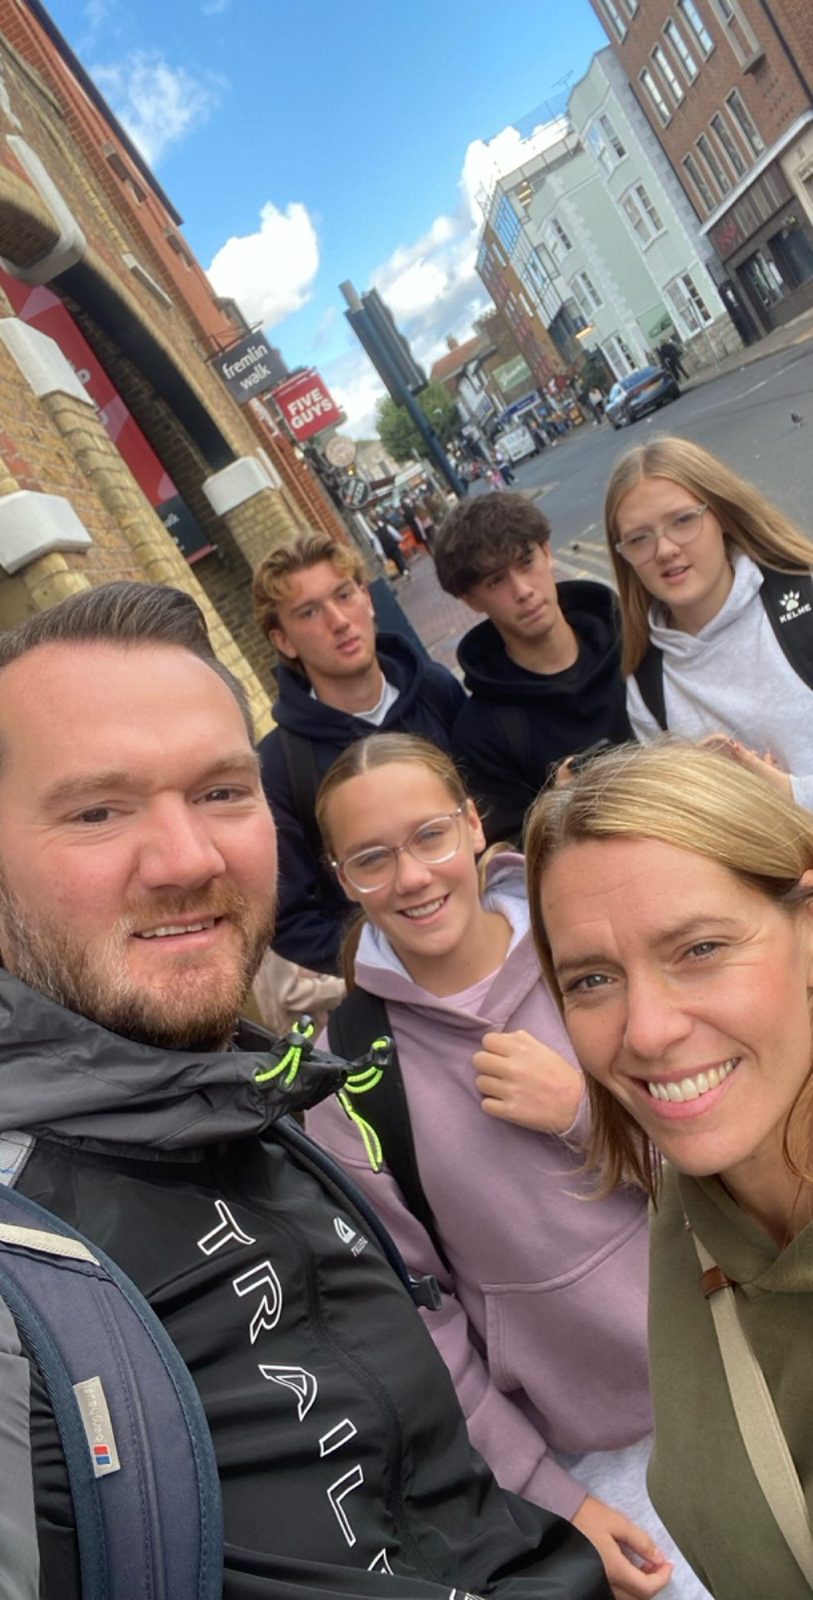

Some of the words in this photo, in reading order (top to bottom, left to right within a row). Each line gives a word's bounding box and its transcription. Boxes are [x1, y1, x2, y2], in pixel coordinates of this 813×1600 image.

[222, 343, 269, 380] fremlin
[239, 364, 271, 390] walk
[287, 388, 324, 416] FIVE
[290, 399, 334, 429] GUYS
[779, 603, 812, 624] KELME
